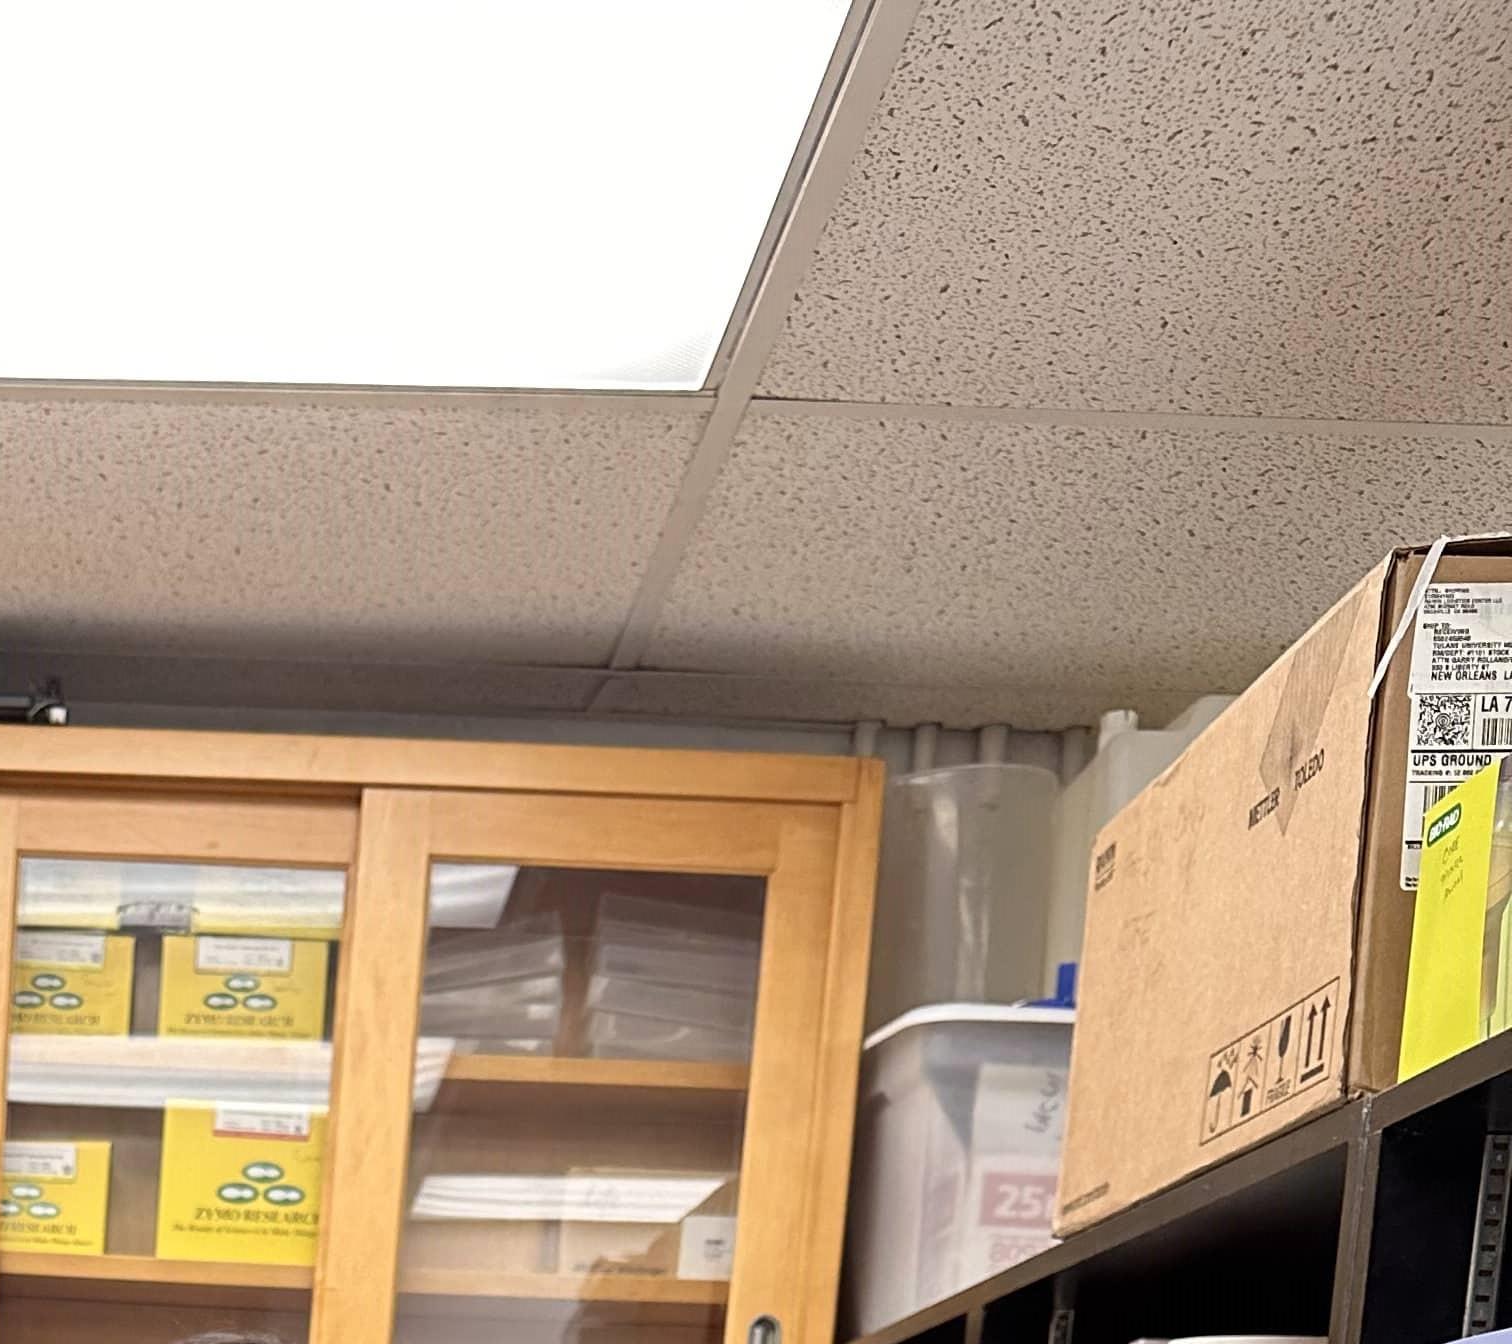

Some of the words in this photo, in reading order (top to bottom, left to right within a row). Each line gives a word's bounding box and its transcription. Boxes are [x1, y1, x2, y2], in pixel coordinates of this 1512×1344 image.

[1431, 671, 1452, 680] NEW
[1456, 671, 1497, 680] ORLEANS
[1482, 696, 1499, 712] LA
[1413, 755, 1437, 766] UPS
[1442, 755, 1492, 766] GROUND
[1248, 787, 1280, 830] METTLER
[1294, 748, 1324, 791] TOLEDO
[1429, 807, 1460, 839] BIO-RAD
